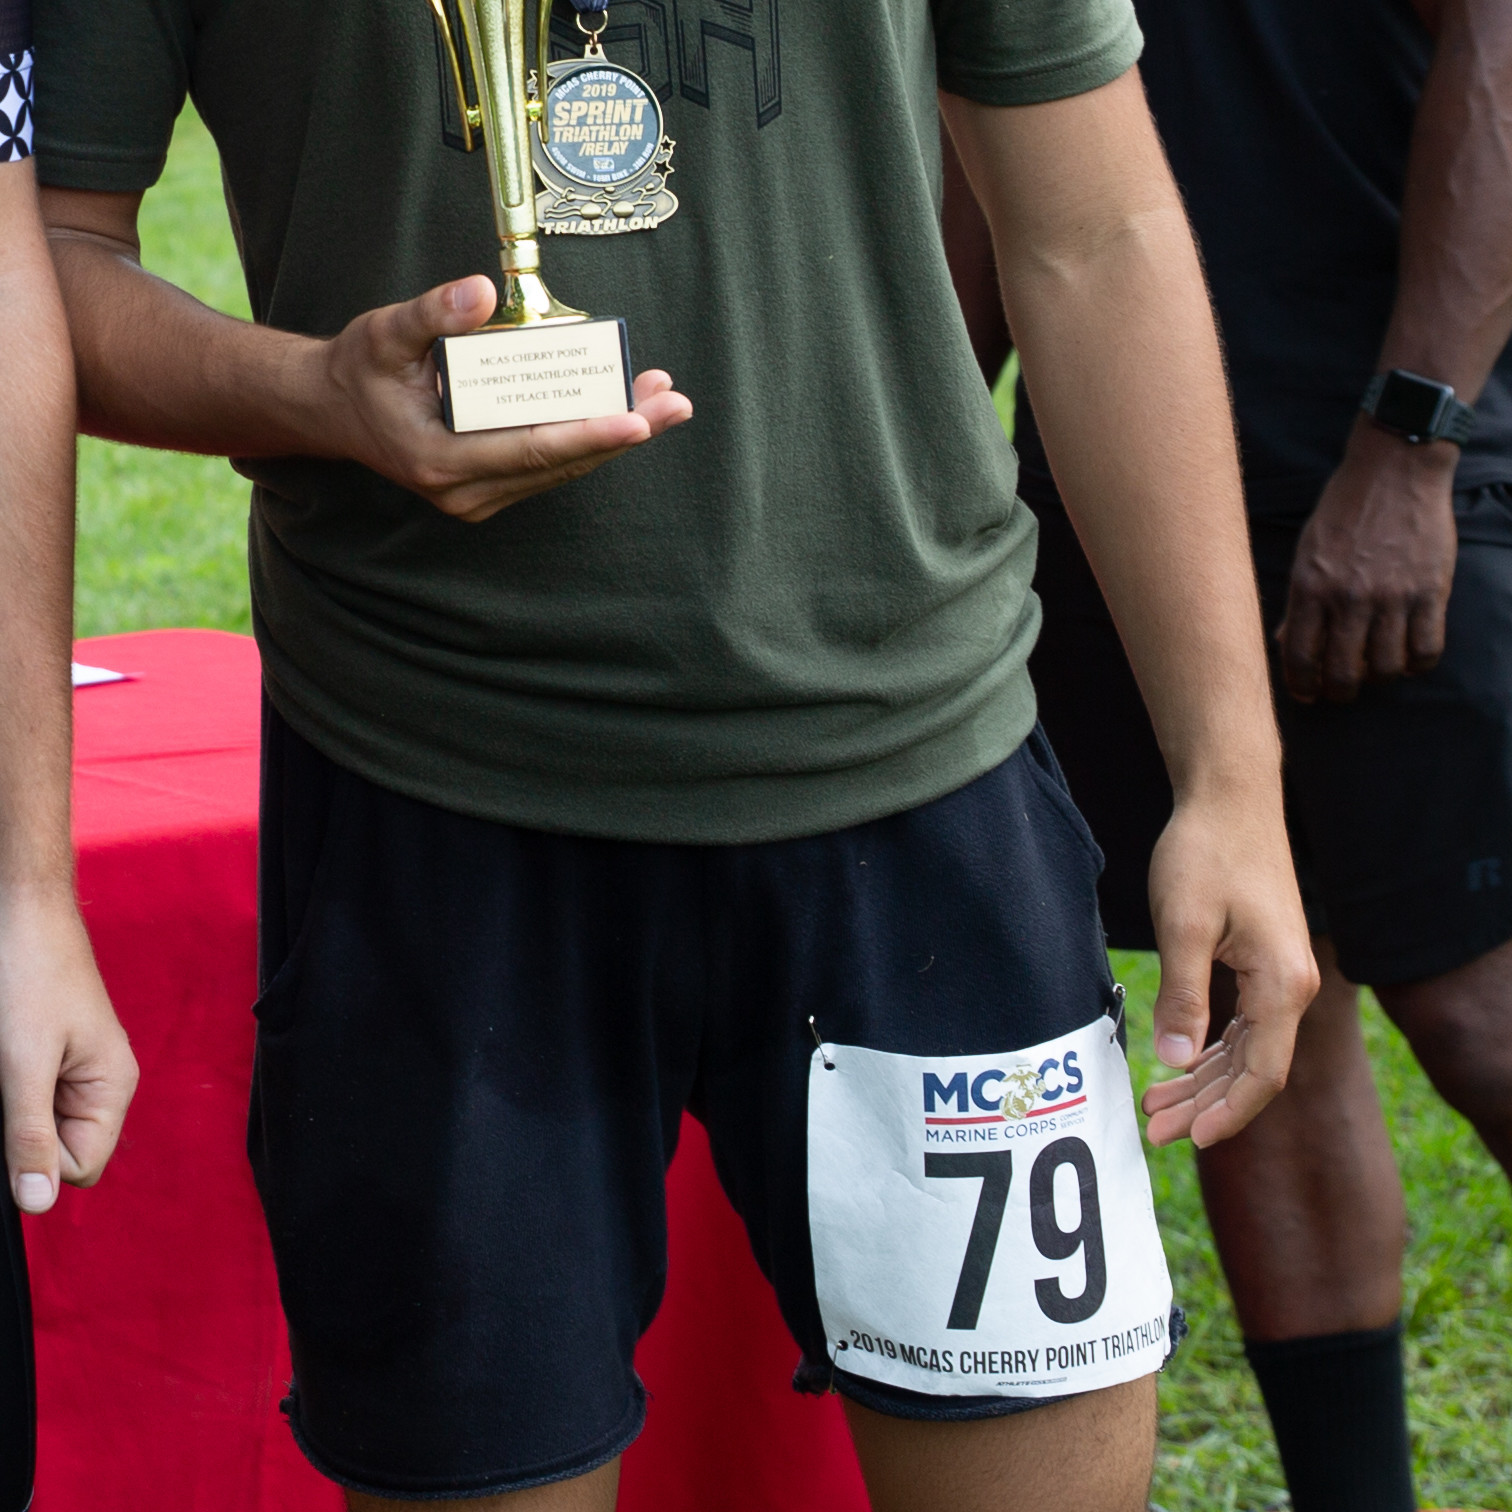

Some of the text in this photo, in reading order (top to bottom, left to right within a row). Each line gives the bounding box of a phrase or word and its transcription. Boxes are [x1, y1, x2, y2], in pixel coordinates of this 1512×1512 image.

[555, 71, 645, 100] MCAS CHERRY POINT
[581, 84, 617, 98] 2019
[552, 99, 649, 126] SPRINT
[552, 124, 644, 143] TRIATHLON
[578, 142, 629, 157] /RELAY
[543, 216, 659, 235] TRIATHLON
[480, 347, 588, 366] MCAS CHERRY POINT
[457, 364, 615, 388] 2019 SPRINT TRIATHLON RELAY
[496, 388, 582, 404] 1ST PLACE TEAM
[926, 1117, 1058, 1143] MARINE CORPS
[923, 1136, 1108, 1331] 79
[850, 1313, 1166, 1375] 2019 MCAS CHERRY POINT TRIATHLON
